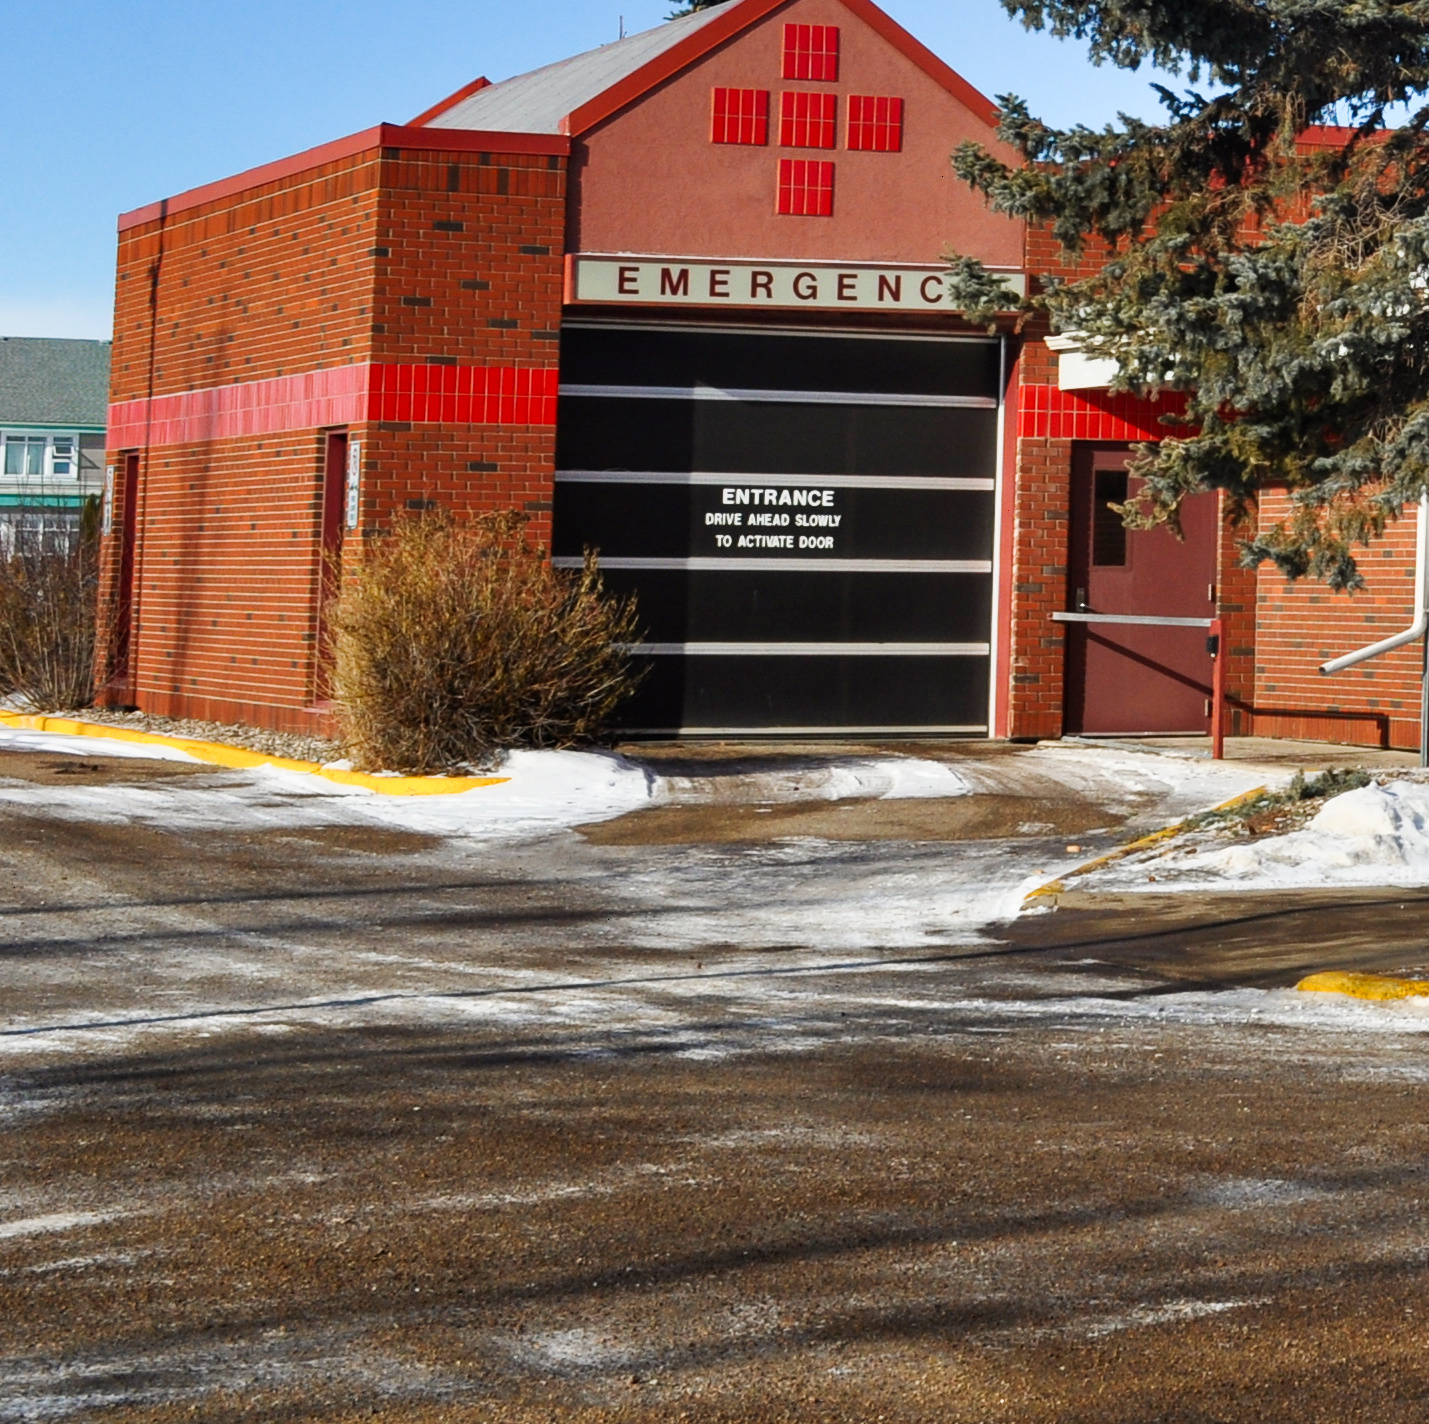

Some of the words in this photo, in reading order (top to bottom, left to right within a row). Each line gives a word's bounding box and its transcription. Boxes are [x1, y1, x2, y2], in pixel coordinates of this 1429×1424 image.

[617, 265, 985, 305] EMERGENC
[722, 487, 835, 507] ENTRANCE
[705, 512, 742, 526] DRIVE
[747, 513, 790, 527] AHEAD
[794, 514, 841, 528] SLOWLY
[715, 534, 732, 548] TO
[737, 534, 794, 549] ACTIVATE
[798, 535, 834, 549] DOOR
